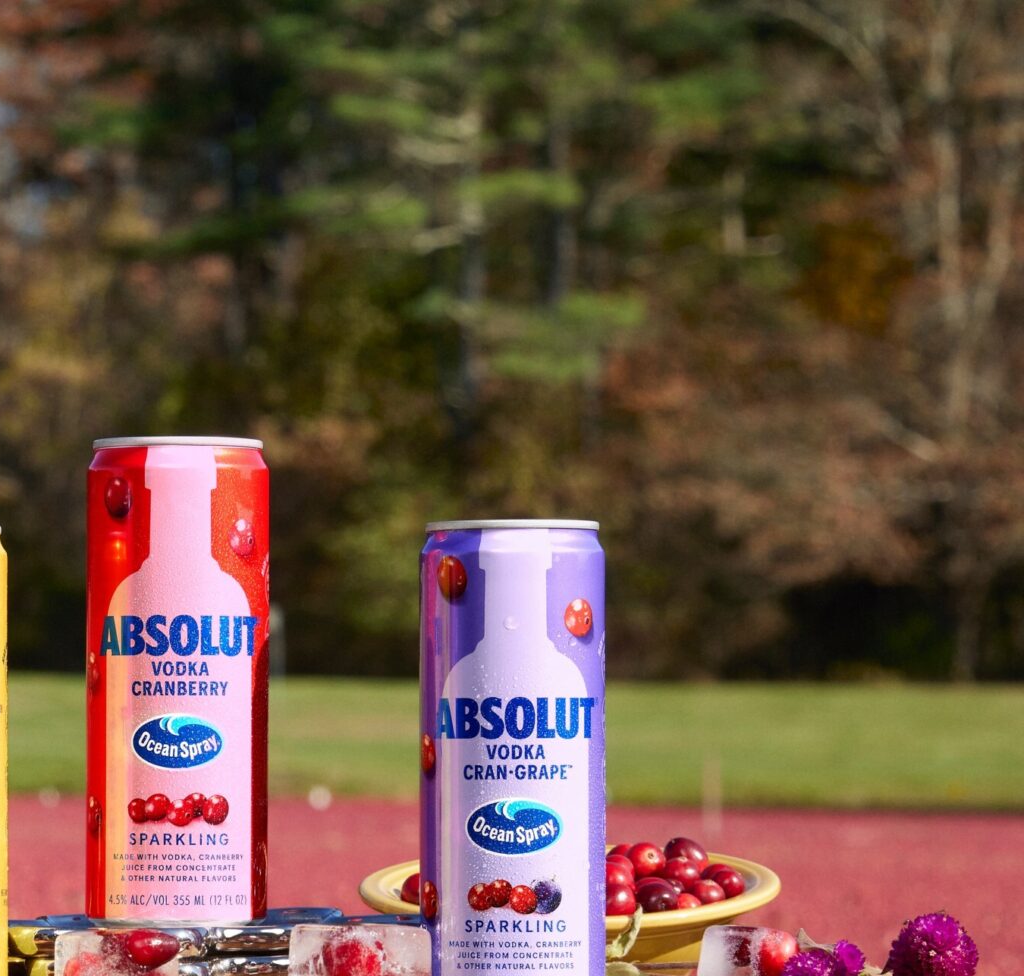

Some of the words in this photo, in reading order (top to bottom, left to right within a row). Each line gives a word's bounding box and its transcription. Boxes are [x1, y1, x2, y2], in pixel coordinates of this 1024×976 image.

[100, 614, 257, 657] ABSOLUT
[151, 661, 209, 677] VODKA
[131, 681, 228, 697] CRANBERRY
[434, 696, 595, 740] ABSOLUT
[138, 731, 177, 758] Ocean
[179, 735, 218, 760] Spray
[486, 744, 546, 760] VODKA
[473, 816, 514, 843] Ocean
[516, 819, 556, 845] Spray
[129, 833, 229, 846] SPARKLING
[162, 853, 196, 861] VODKA,
[108, 895, 127, 905] 4.5%
[130, 894, 170, 907] ALC/VOL
[173, 895, 190, 905] 355
[194, 895, 205, 905] ML
[465, 920, 567, 933] SPARKLING
